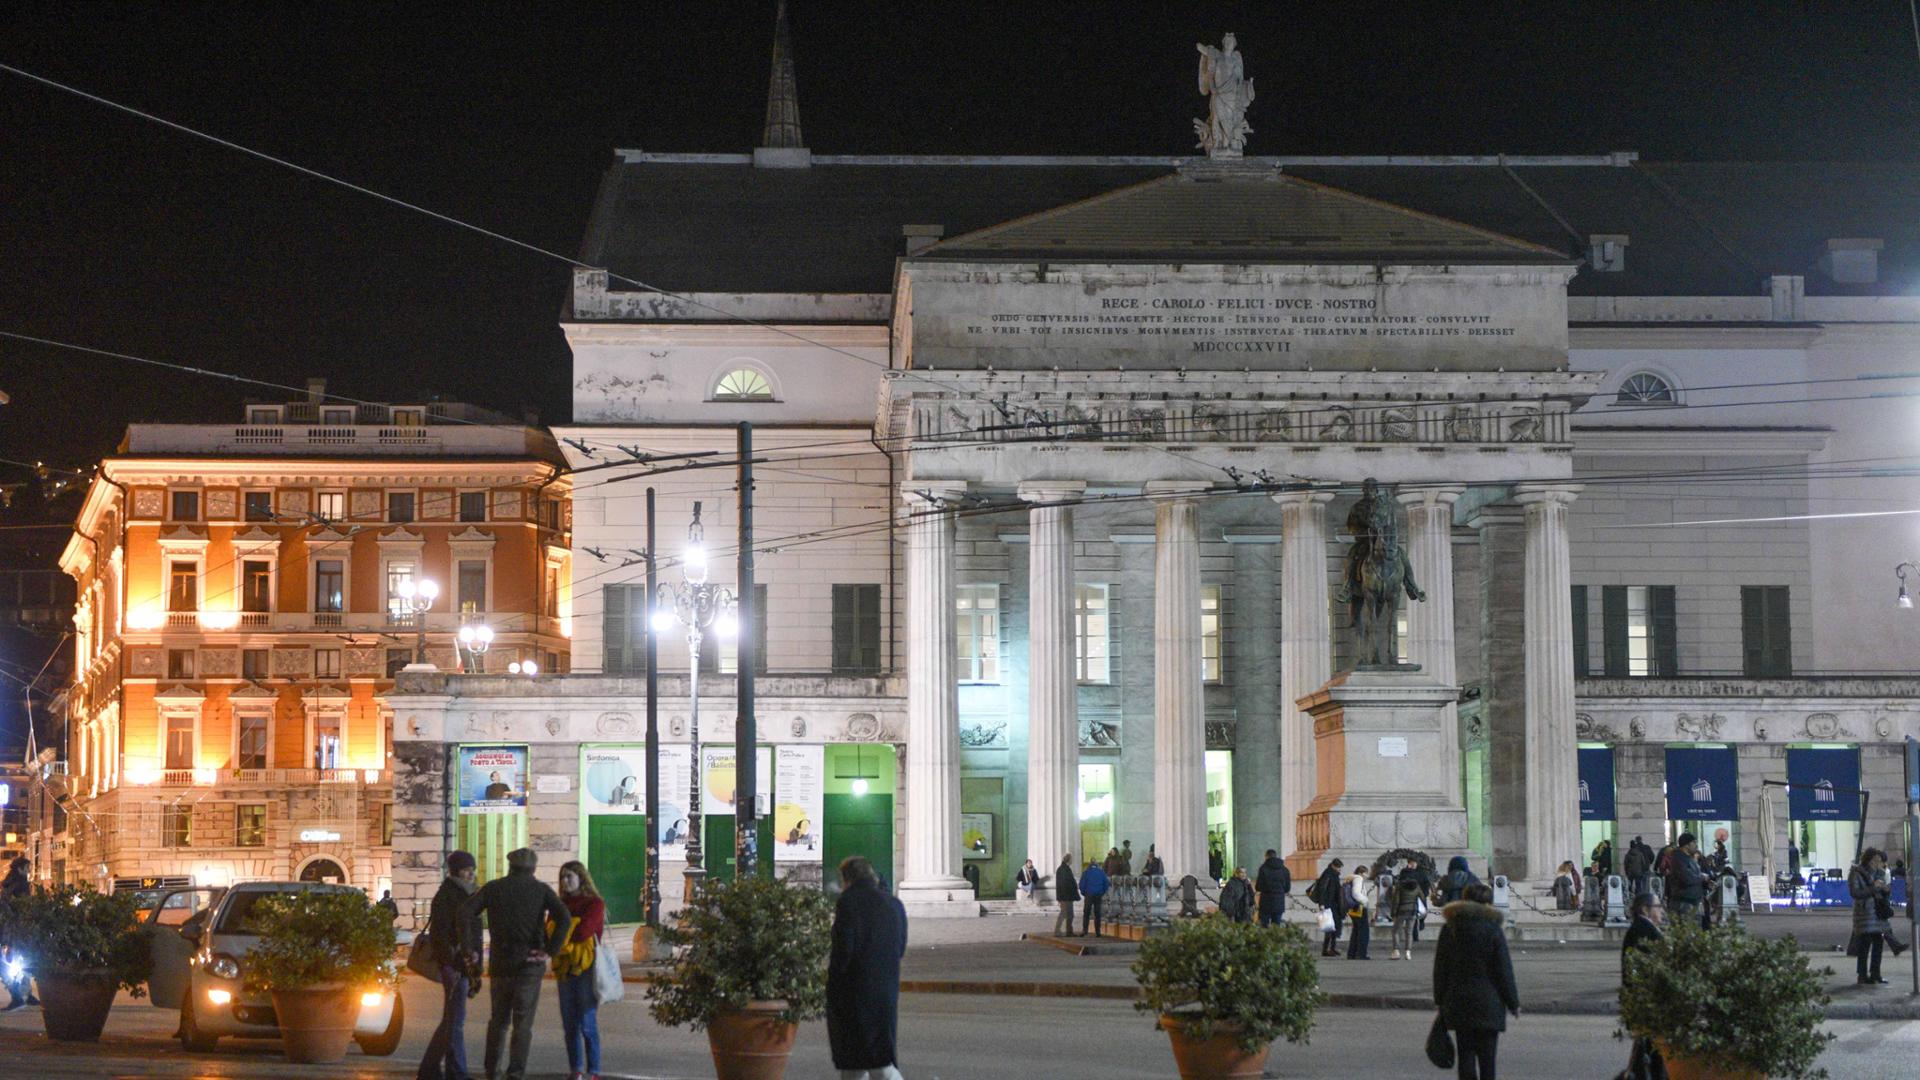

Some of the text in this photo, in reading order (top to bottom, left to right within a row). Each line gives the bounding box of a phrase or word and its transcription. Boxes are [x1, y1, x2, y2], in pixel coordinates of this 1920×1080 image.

[1152, 298, 1205, 309] CAROLO
[1217, 299, 1265, 309] FELICI
[1275, 299, 1313, 309] DVCE
[1323, 299, 1377, 309] NOSTRO
[1193, 341, 1291, 352] MDCCCXXVII
